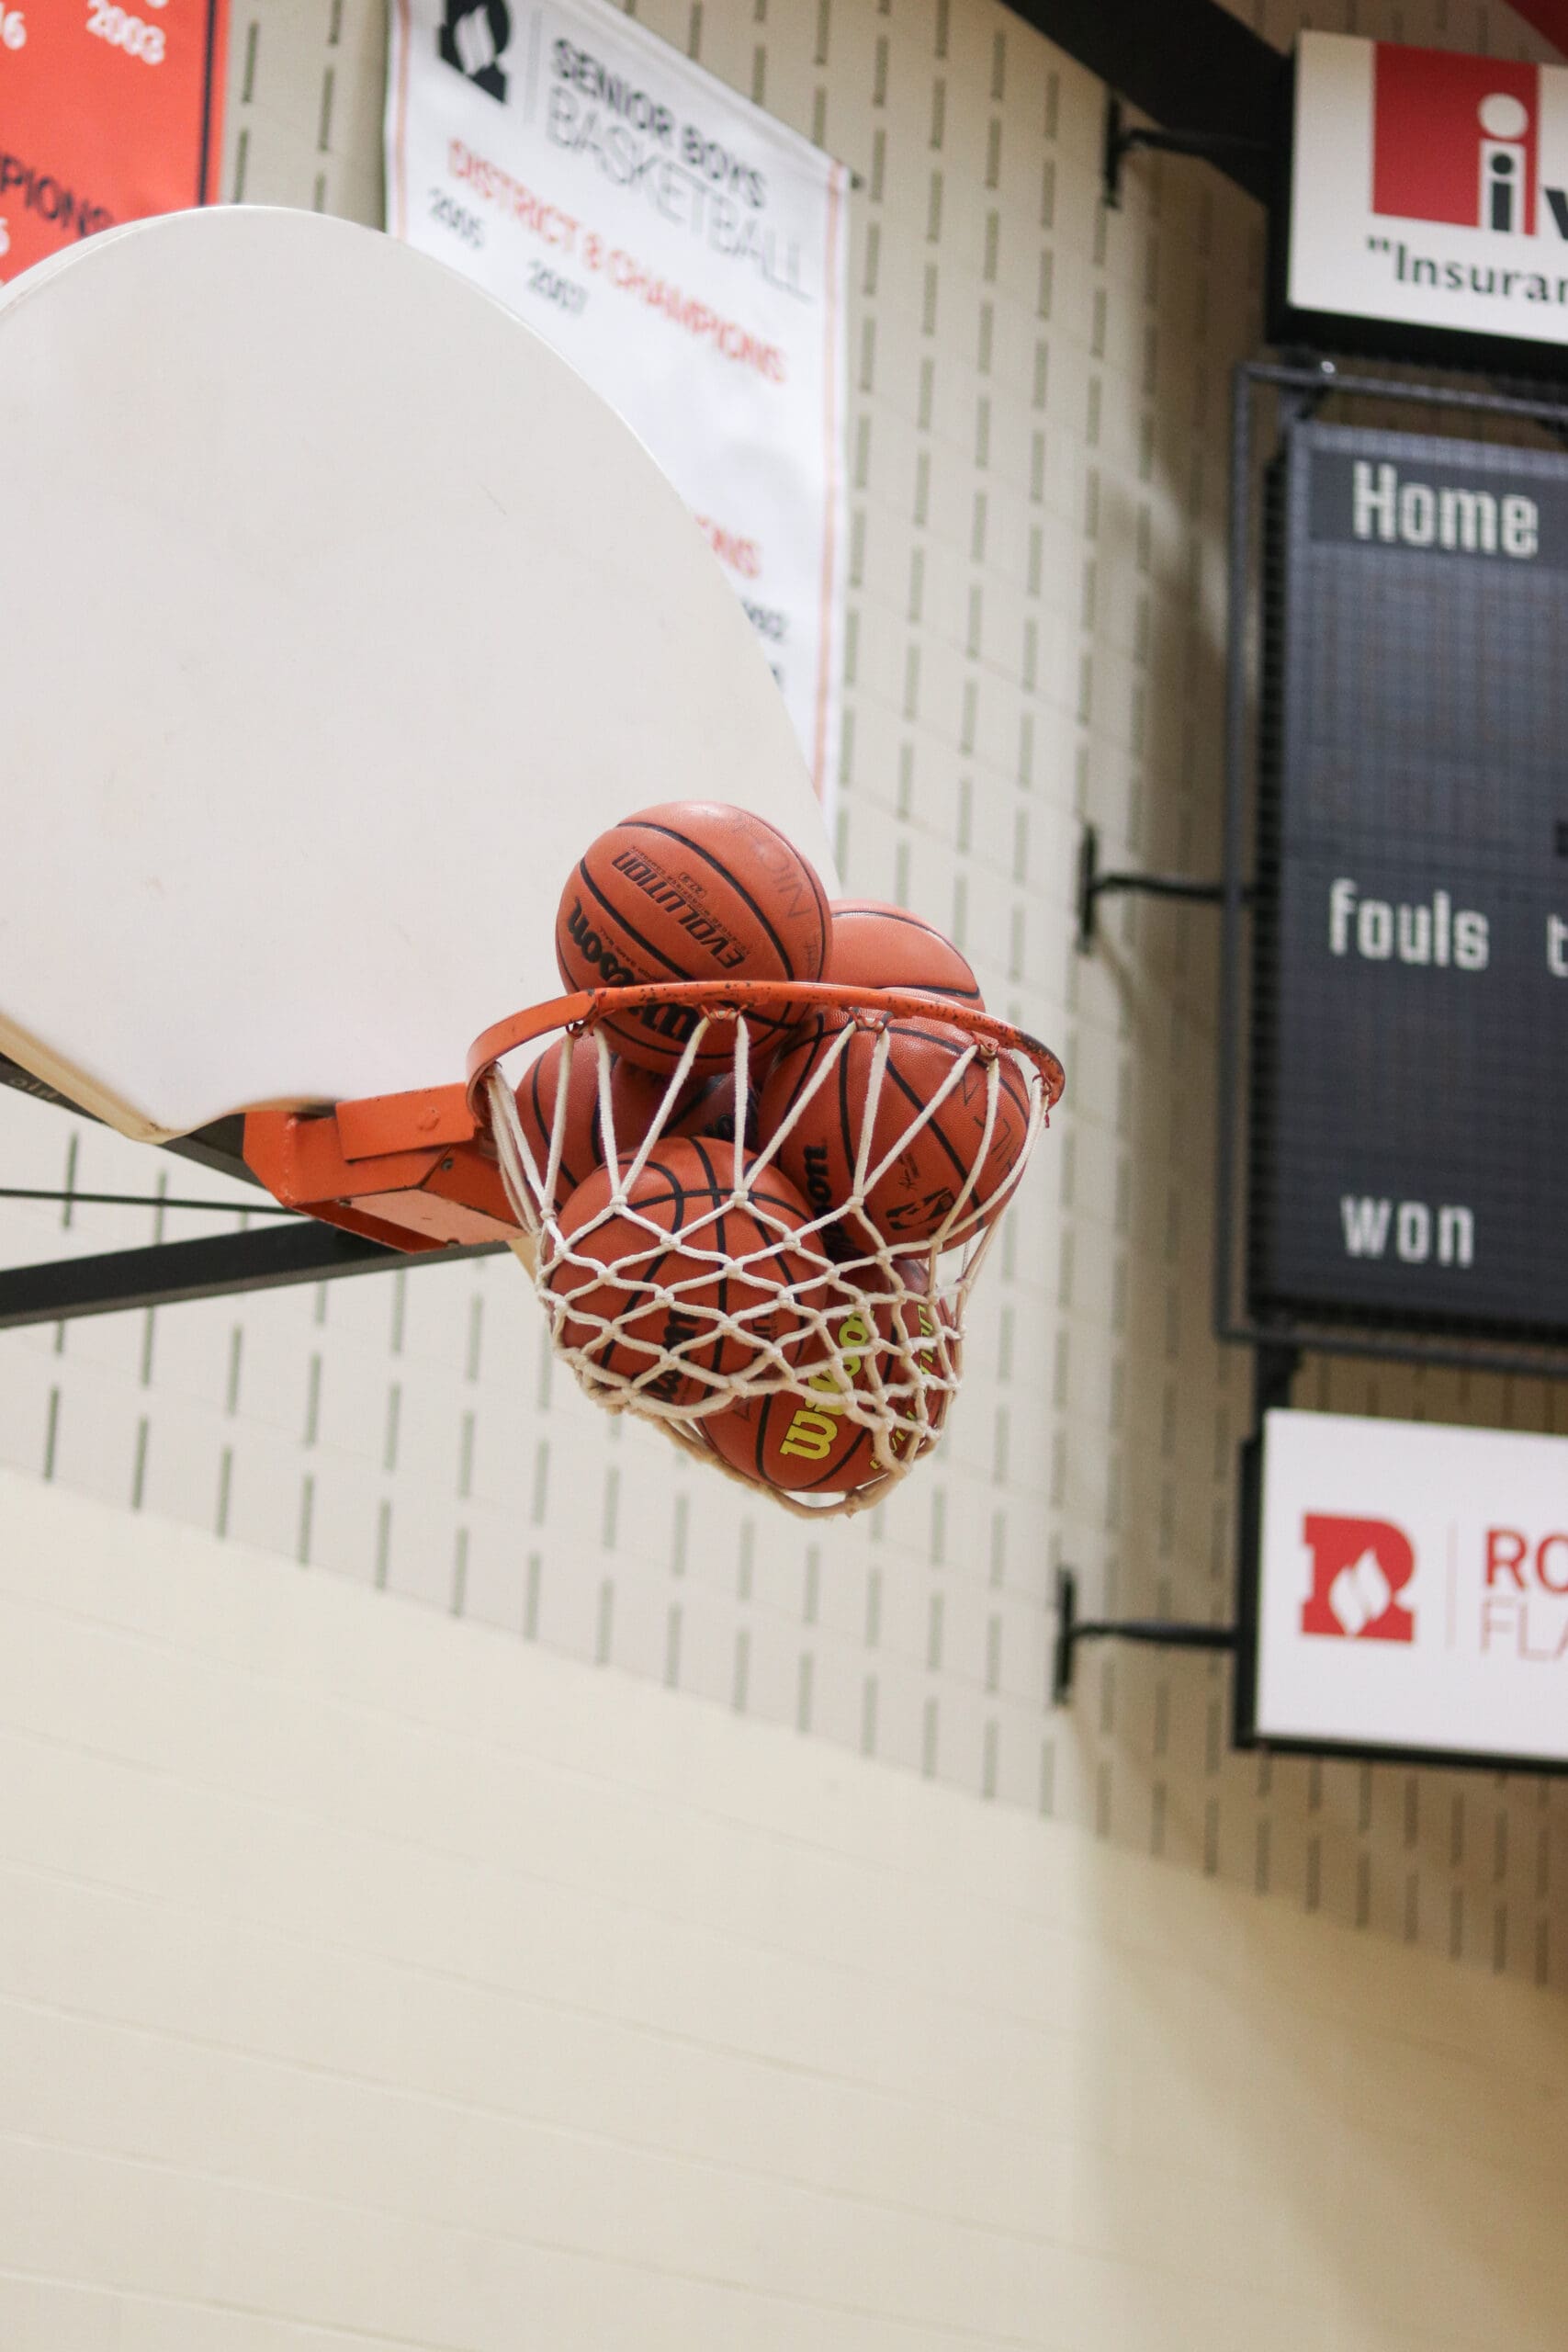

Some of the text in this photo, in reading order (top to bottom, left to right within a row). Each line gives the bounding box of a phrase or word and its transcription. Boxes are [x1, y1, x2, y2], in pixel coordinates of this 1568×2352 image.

[552, 39, 766, 211] SENIOR BOYS
[547, 85, 815, 306] BASKETBALL
[447, 138, 580, 254] DISTRICT
[606, 248, 789, 384] CHAMPIONS
[1352, 460, 1540, 559] Home
[612, 851, 746, 969] EVOLUTION
[1329, 877, 1489, 971] fouls
[1340, 1195, 1475, 1268] won
[1482, 1595, 1568, 1664] FL
